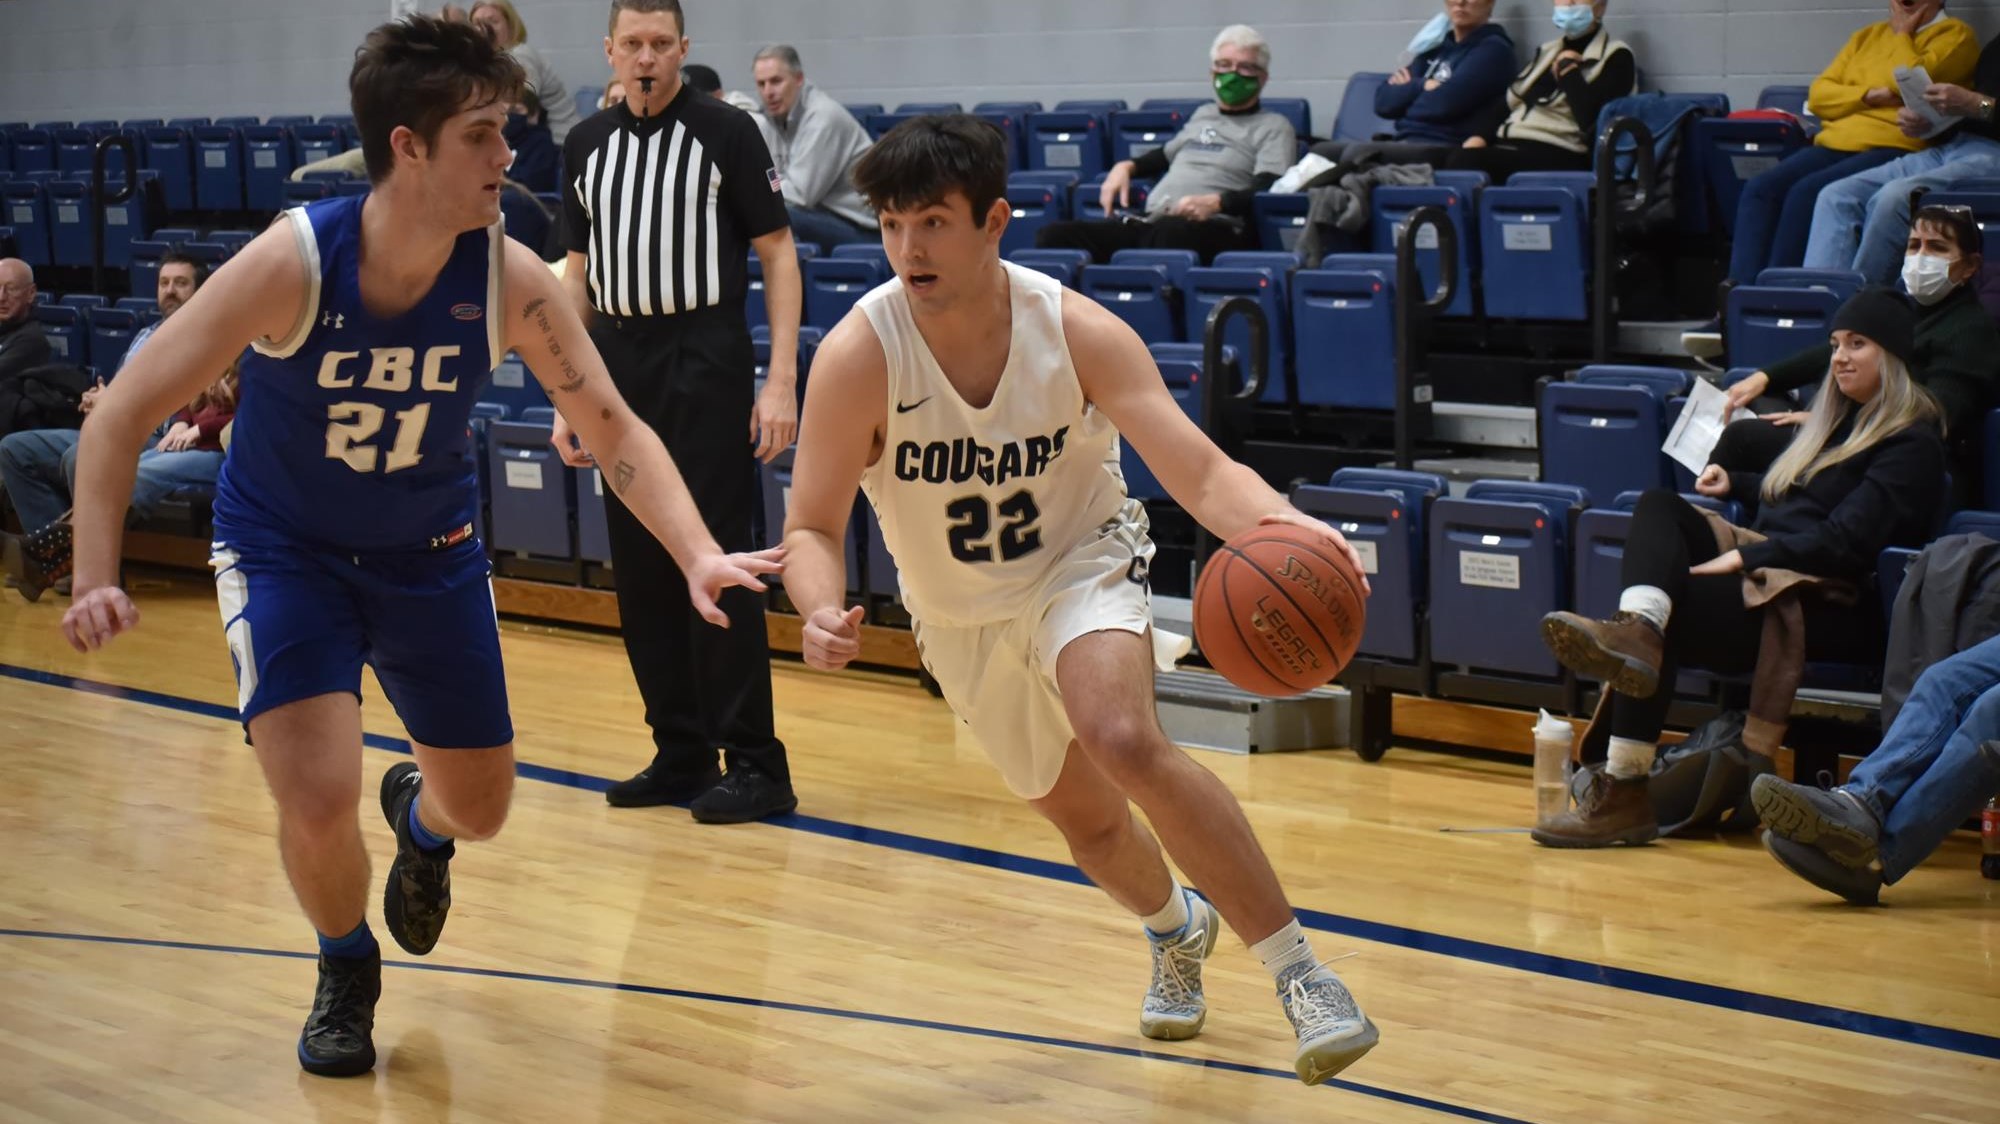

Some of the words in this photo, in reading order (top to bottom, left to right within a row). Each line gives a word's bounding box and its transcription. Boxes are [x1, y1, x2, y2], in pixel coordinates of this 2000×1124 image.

[317, 345, 461, 393] CBC
[325, 401, 431, 473] 21
[895, 424, 1070, 486] COUGARS
[945, 488, 1045, 563] 22
[1255, 595, 1322, 670] LEGACY
[1274, 554, 1355, 647] SPALDIN
